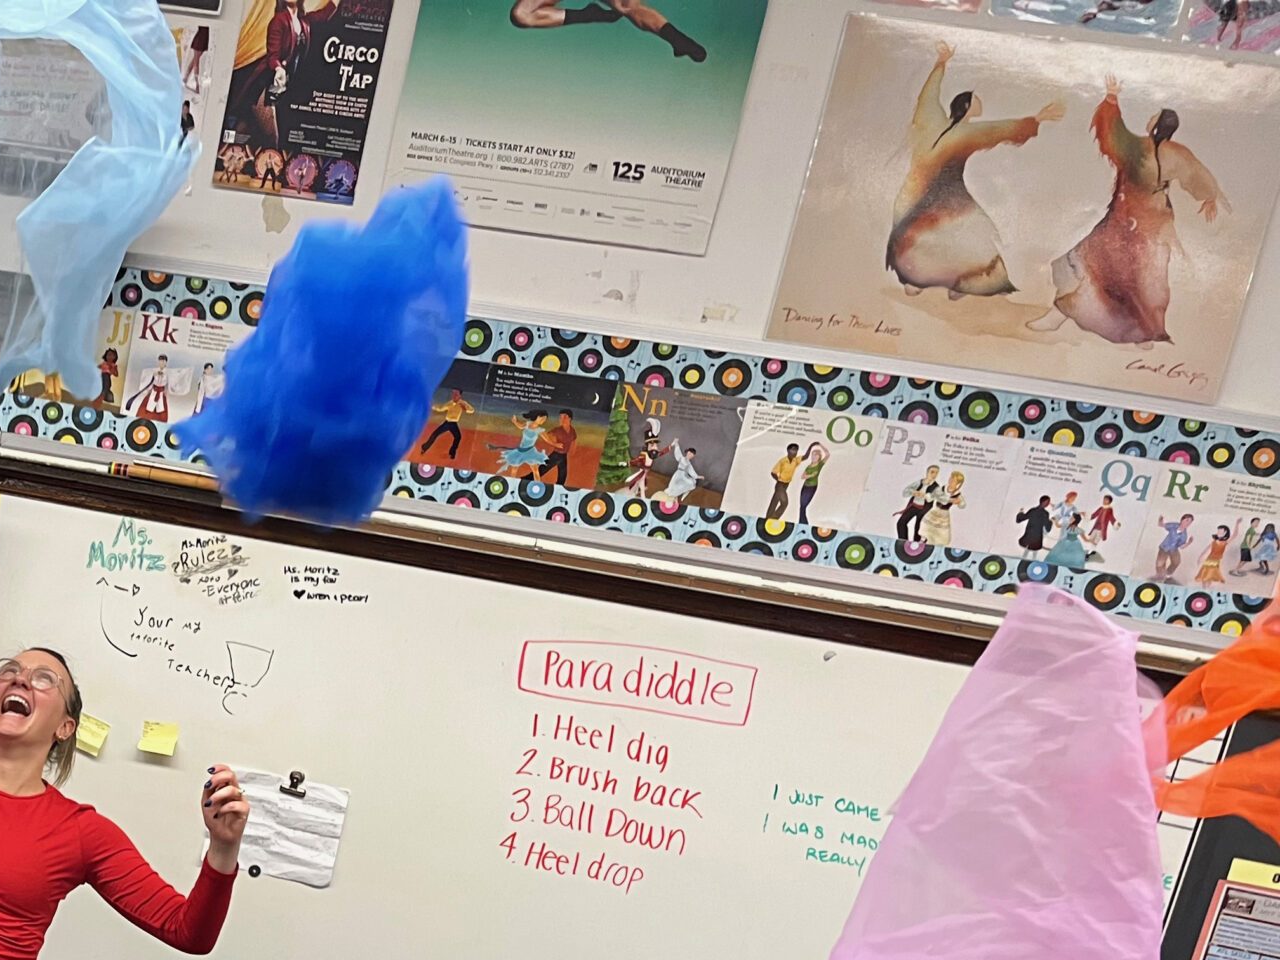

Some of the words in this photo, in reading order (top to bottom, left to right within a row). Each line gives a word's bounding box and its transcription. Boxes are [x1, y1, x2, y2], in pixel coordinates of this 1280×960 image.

[323, 36, 380, 63] CIRCO
[338, 63, 373, 91] TAP
[411, 131, 439, 142] MARCH
[465, 138, 498, 150] TICKETS
[498, 143, 523, 153] START
[524, 145, 535, 154] AT
[536, 147, 556, 157] ONLY
[613, 161, 646, 181] 125
[651, 165, 705, 179] AUDITORIUM
[665, 176, 703, 188] THEATRE
[107, 311, 132, 347] Jj
[139, 314, 179, 345] Kk
[620, 384, 668, 417] Nn
[826, 415, 873, 447] Oo
[880, 425, 926, 465] Pp
[1099, 459, 1152, 502] Qq
[1163, 469, 1209, 502] Rr
[112, 517, 153, 547] Ms.
[87, 540, 167, 571] Moritz
[304, 565, 340, 576] Moritz
[304, 576, 320, 587] my
[133, 606, 174, 628] Your
[554, 714, 615, 753] Heel
[627, 732, 669, 773] dig
[549, 756, 618, 795] Brush
[634, 776, 703, 819] back
[789, 789, 824, 807] JUST
[834, 798, 881, 822] CAME
[543, 794, 594, 834] Ball
[605, 808, 686, 856] Down
[524, 841, 580, 876] Heel
[587, 852, 644, 895] drop
